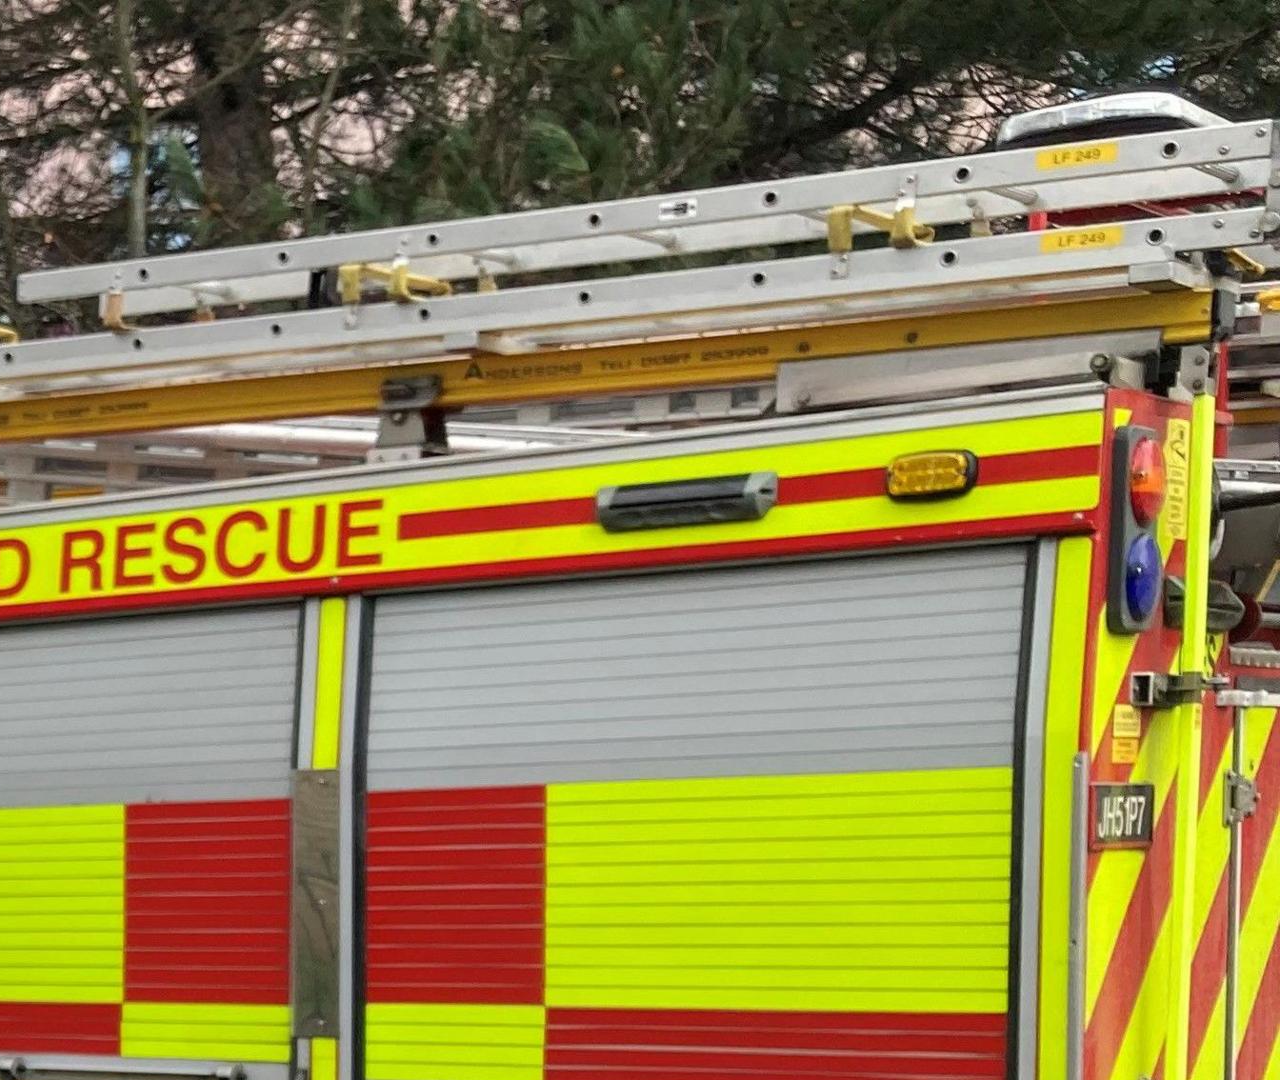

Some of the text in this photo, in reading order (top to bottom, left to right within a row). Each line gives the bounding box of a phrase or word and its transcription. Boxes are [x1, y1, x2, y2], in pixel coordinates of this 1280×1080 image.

[1052, 148, 1101, 165] LF 249
[1058, 232, 1106, 248] LF 249
[60, 499, 384, 595] RESCUE
